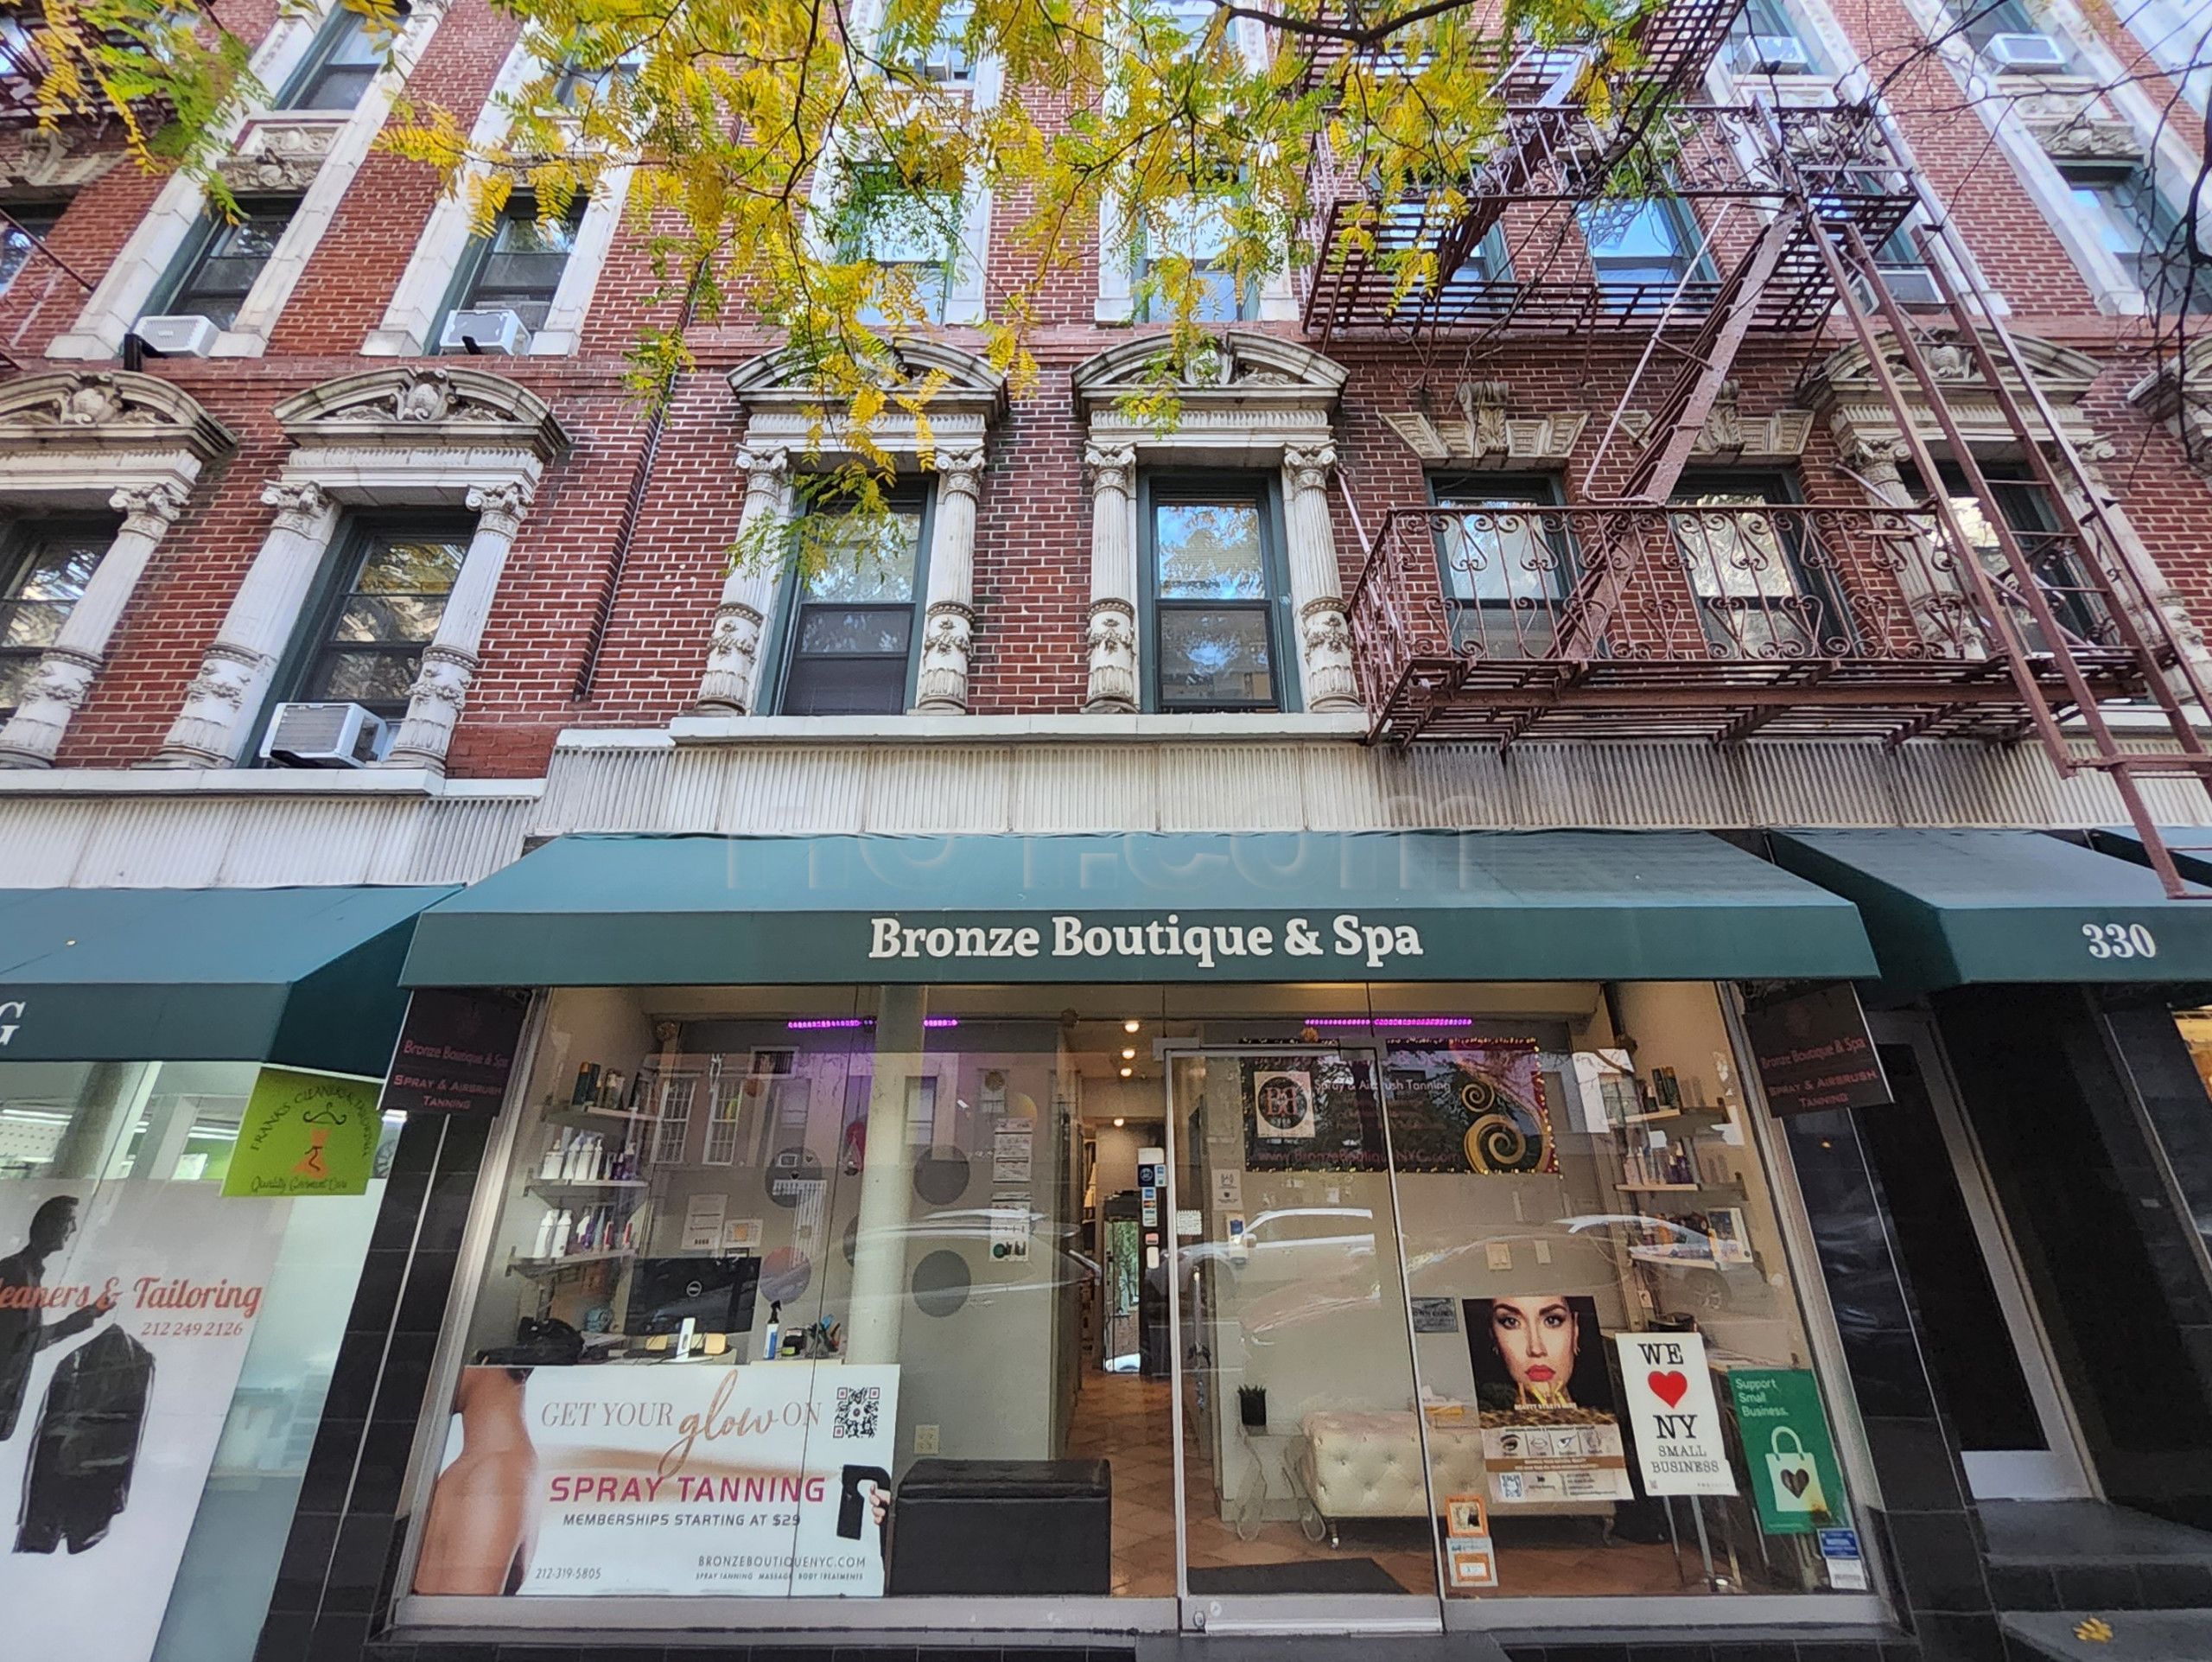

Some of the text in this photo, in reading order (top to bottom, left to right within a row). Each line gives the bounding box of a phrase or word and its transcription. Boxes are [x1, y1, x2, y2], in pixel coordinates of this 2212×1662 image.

[868, 914, 1423, 967] Bronze Boutique & Spa
[2082, 923, 2156, 958] 330
[403, 1040, 441, 1059] Bronze
[1845, 1036, 1866, 1053] Spa
[1407, 1079, 1452, 1093] Tanning
[423, 1095, 471, 1110] TANNING
[95, 1277, 123, 1310] &
[133, 1277, 263, 1318] Tailoring
[141, 1322, 243, 1336] 212 249 2126
[1638, 1343, 1684, 1366] WE
[1735, 1378, 1777, 1391] Support
[1739, 1391, 1766, 1404] Small
[1743, 1404, 1789, 1417] Business.
[542, 1369, 822, 1480] GET YOUR glow ON
[1653, 1415, 1697, 1438] NY
[1658, 1445, 1707, 1457] SMALL
[1652, 1461, 1719, 1473] BUSINESS
[550, 1476, 825, 1503] SPRAY TANNING
[563, 1513, 801, 1527] MEMBERSHIPS STARTING AT $29
[698, 1556, 866, 1568] BRONZEBOUTIQUENYC.COM
